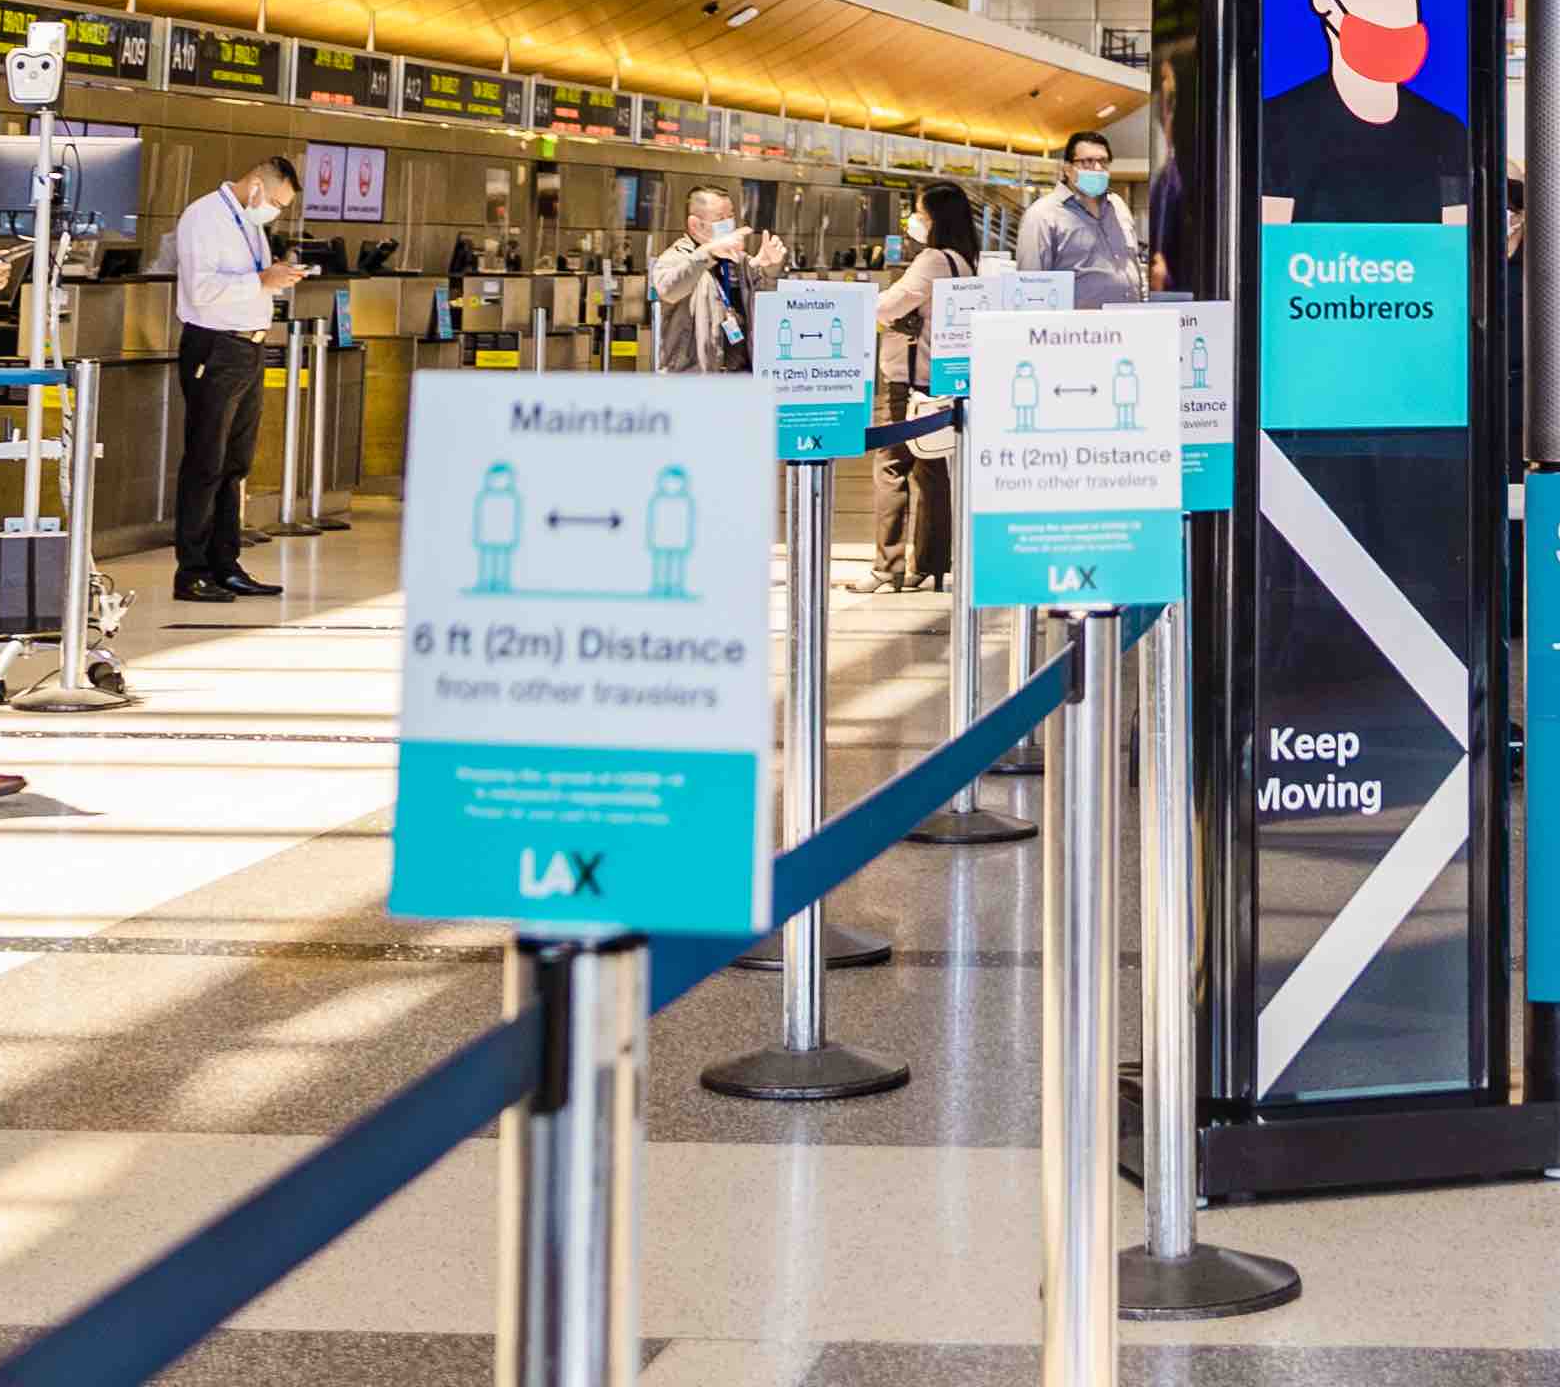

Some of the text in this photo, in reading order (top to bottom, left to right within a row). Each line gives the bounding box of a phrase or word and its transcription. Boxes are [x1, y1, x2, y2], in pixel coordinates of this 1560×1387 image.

[121, 37, 145, 65] A09
[1288, 252, 1414, 286] Quítese
[787, 300, 835, 310] Maintain
[1288, 294, 1433, 320] Sombreros
[1029, 327, 1122, 346] Maintain
[811, 368, 860, 378] Distance
[510, 400, 671, 435] Maintain
[797, 436, 822, 450] LAX
[979, 445, 1172, 470] 6 ft (2m) Distance
[994, 473, 1158, 491] from other travelers
[1048, 565, 1097, 591] LAX
[413, 624, 745, 665] 6 ft (2m) Distance
[436, 676, 717, 707] from other travelers
[1269, 726, 1360, 767] Keep
[520, 849, 605, 896] LAX
